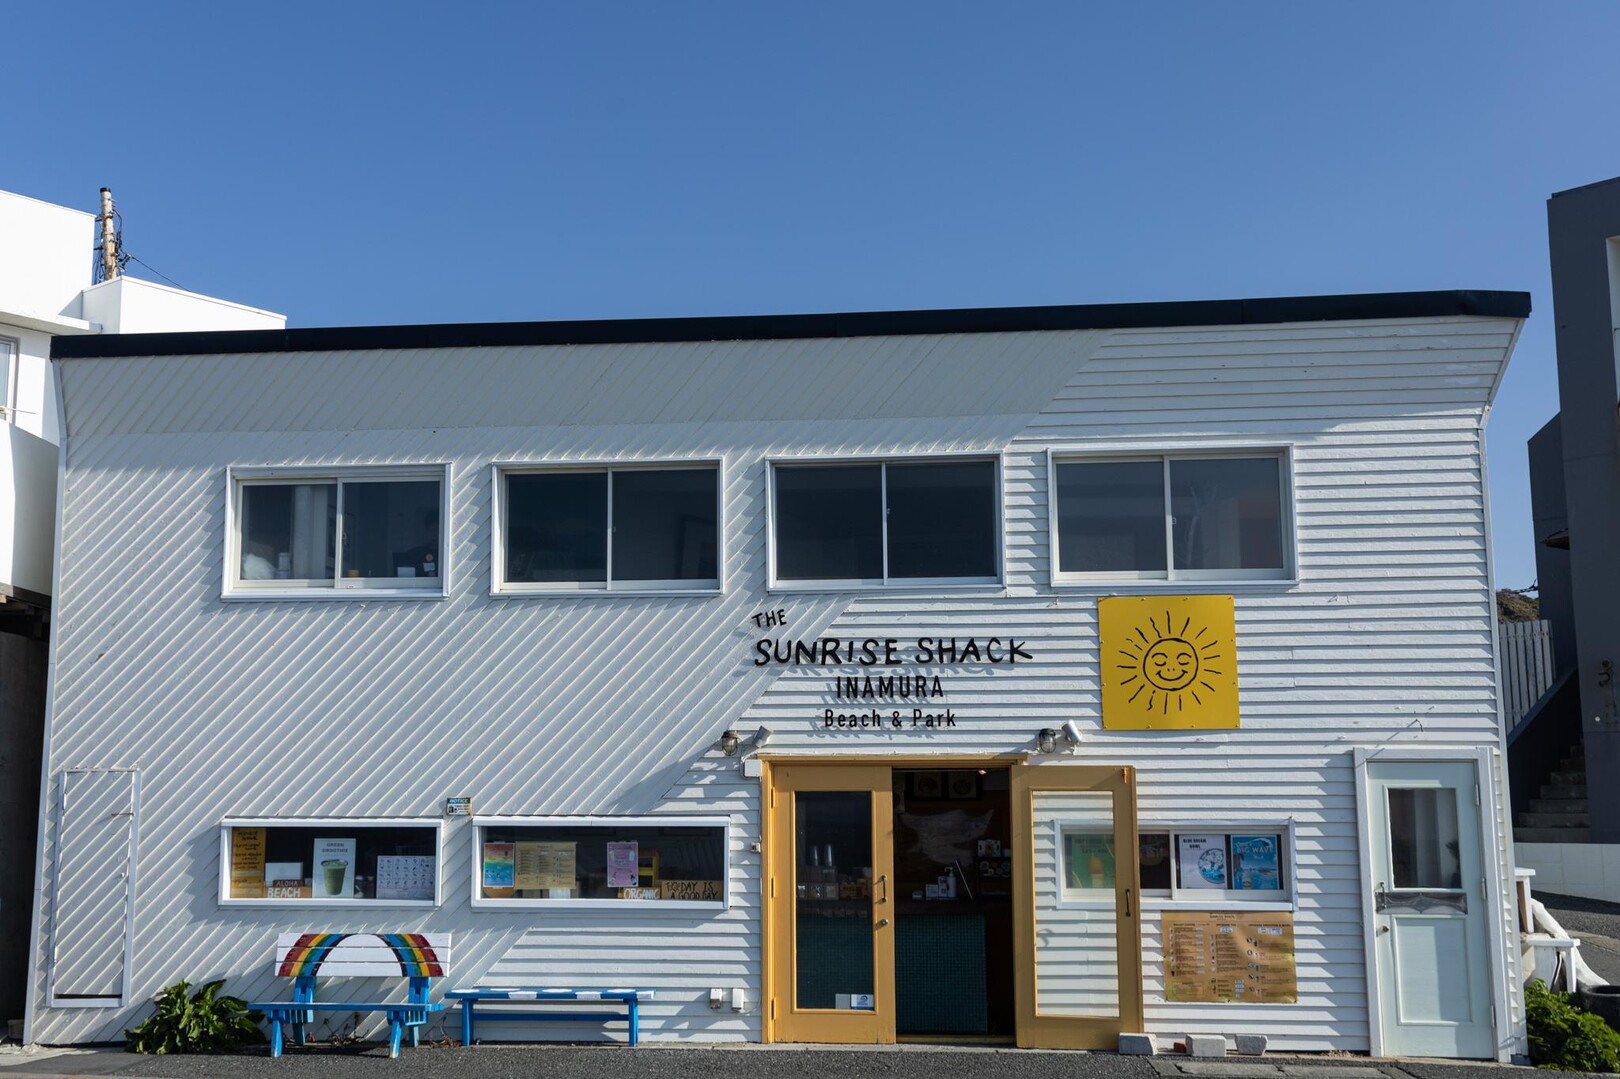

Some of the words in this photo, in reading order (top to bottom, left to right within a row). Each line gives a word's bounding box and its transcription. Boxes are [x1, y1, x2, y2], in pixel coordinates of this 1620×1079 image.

[752, 609, 787, 628] THE
[755, 637, 903, 666] SUNRISE
[915, 637, 1034, 664] SHACK
[836, 675, 945, 699] INAMURA
[824, 709, 881, 728] Beach
[891, 711, 903, 728] &
[912, 709, 957, 728] Park
[267, 887, 301, 898] BEACH
[623, 888, 660, 899] ORGANIC
[703, 882, 714, 892] IS
[679, 891, 700, 899] GOOD
